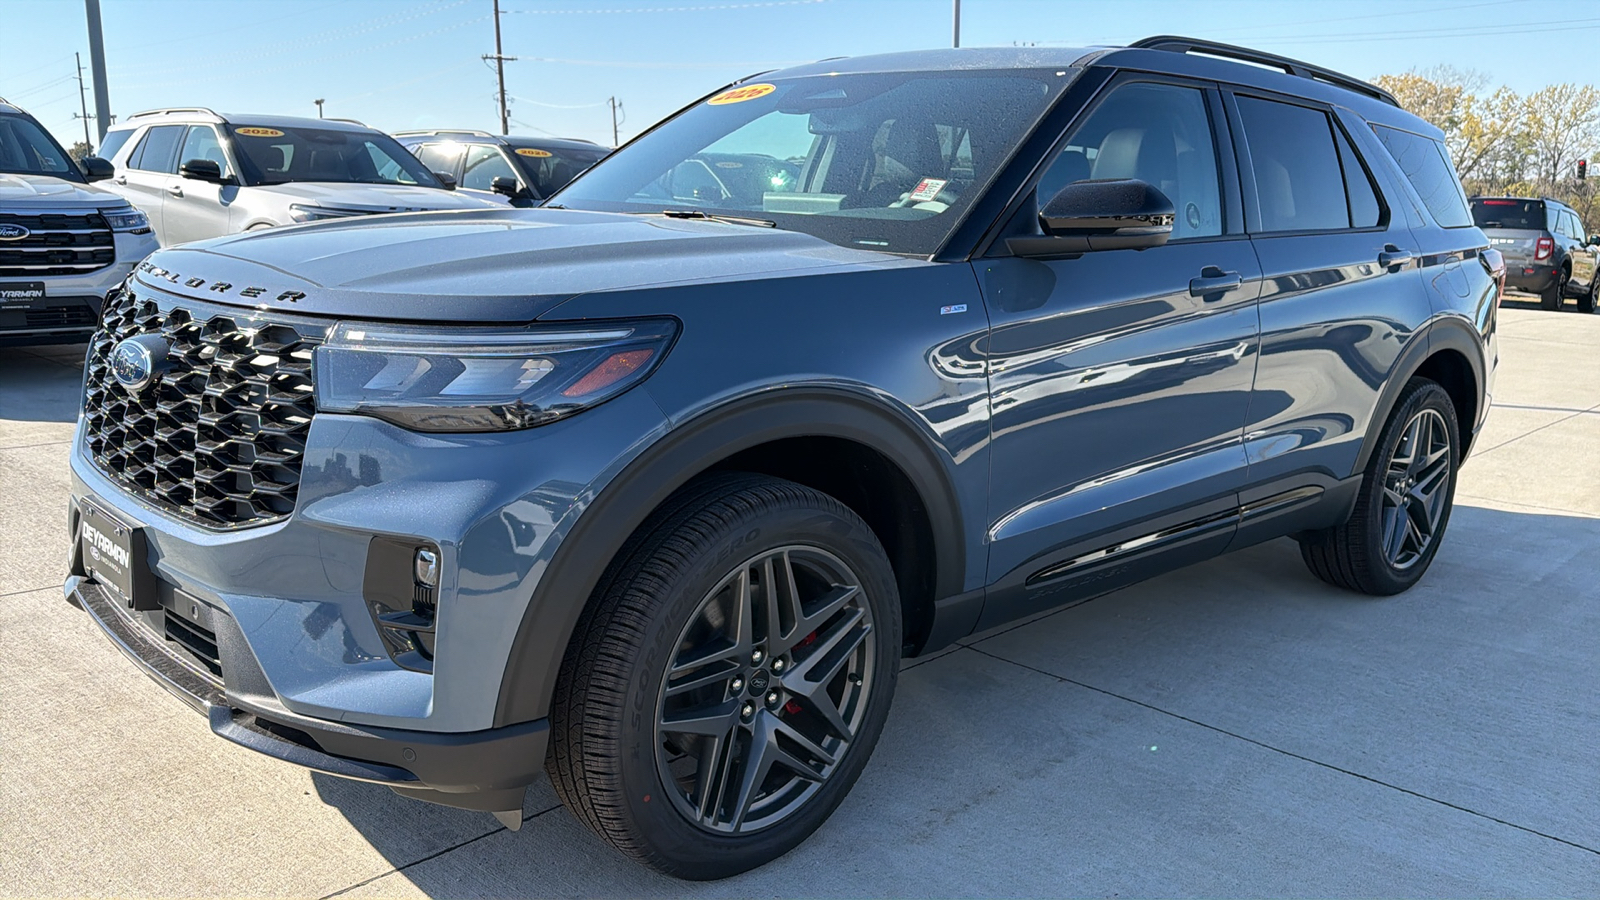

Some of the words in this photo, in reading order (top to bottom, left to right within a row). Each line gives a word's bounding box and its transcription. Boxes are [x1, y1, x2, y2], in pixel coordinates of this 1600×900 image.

[711, 87, 771, 102] 2026
[242, 128, 279, 136] 2026
[82, 521, 130, 569] DEYARMAN
